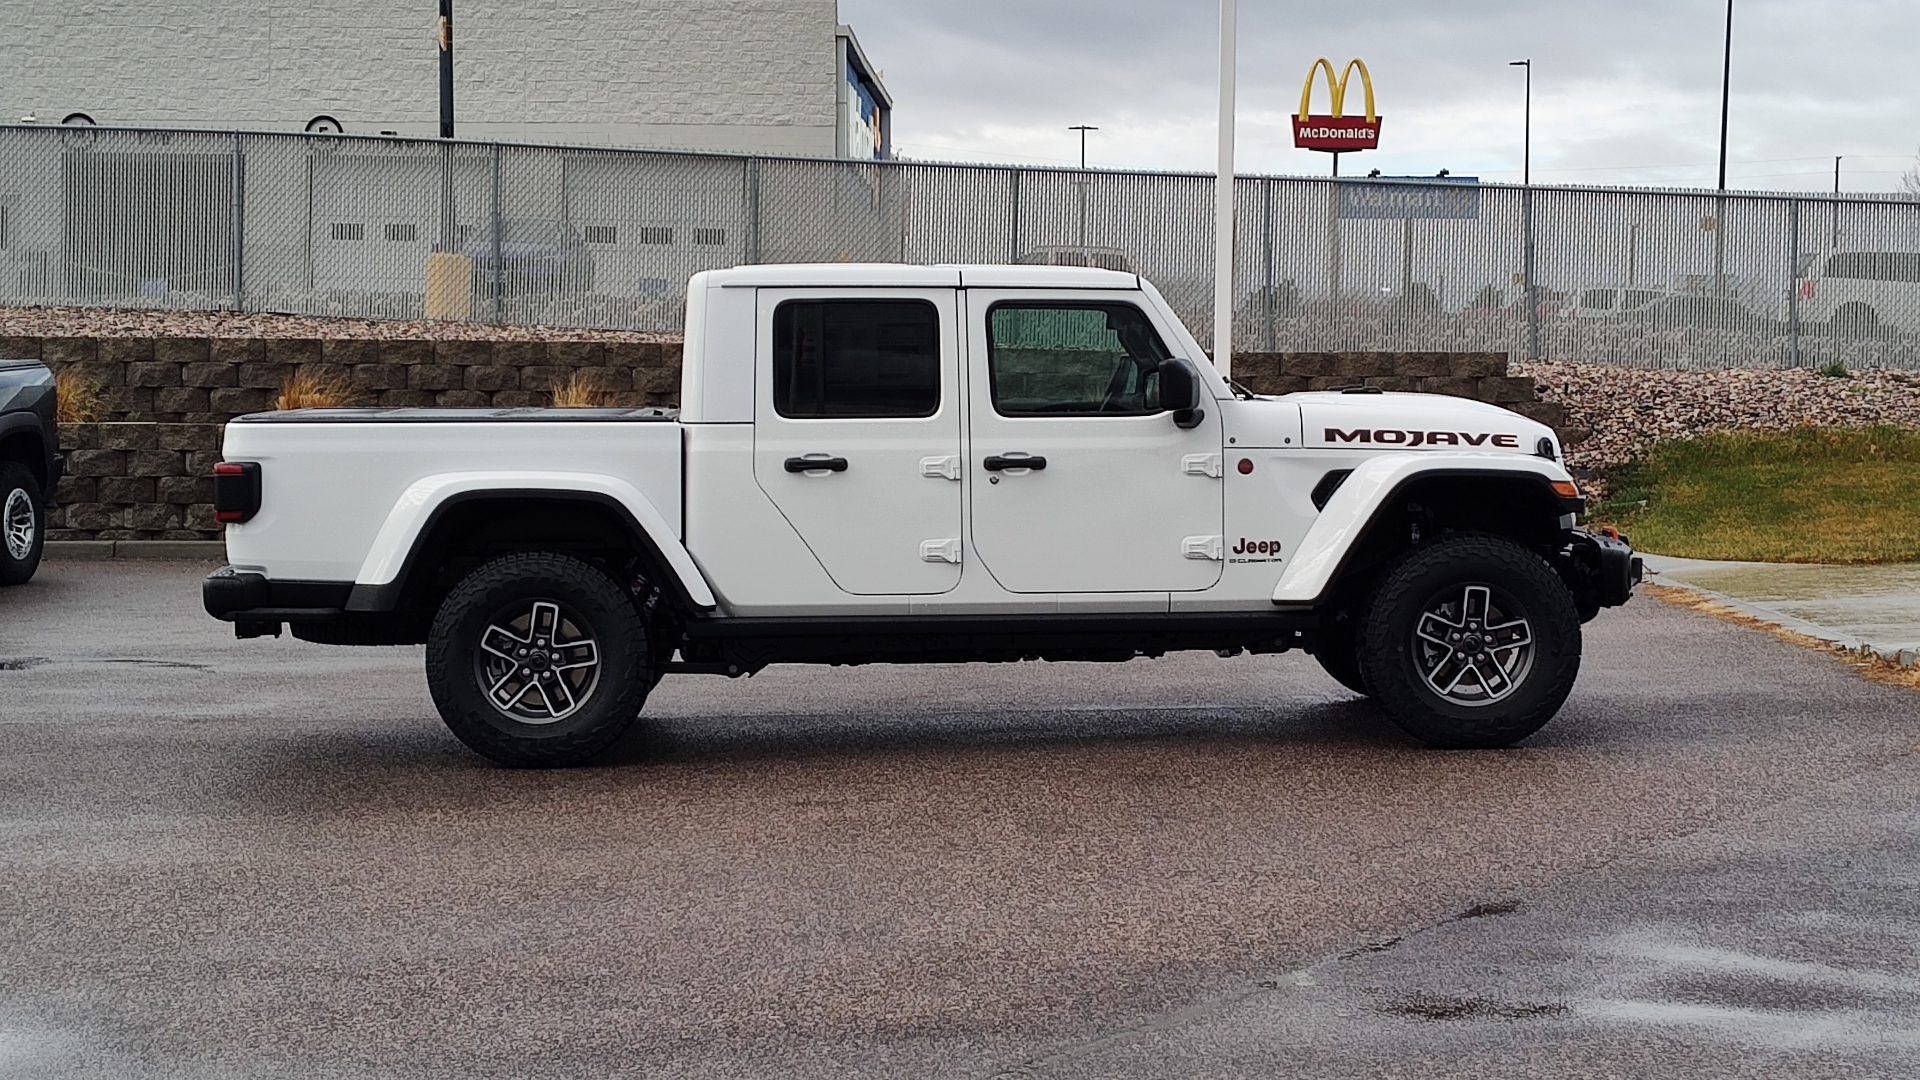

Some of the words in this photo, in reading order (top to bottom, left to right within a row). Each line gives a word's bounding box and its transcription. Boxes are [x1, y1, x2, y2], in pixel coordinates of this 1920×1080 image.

[1299, 127, 1375, 139] McDonald's
[1324, 428, 1519, 448] MOJAVE
[1232, 537, 1281, 556] Jeep
